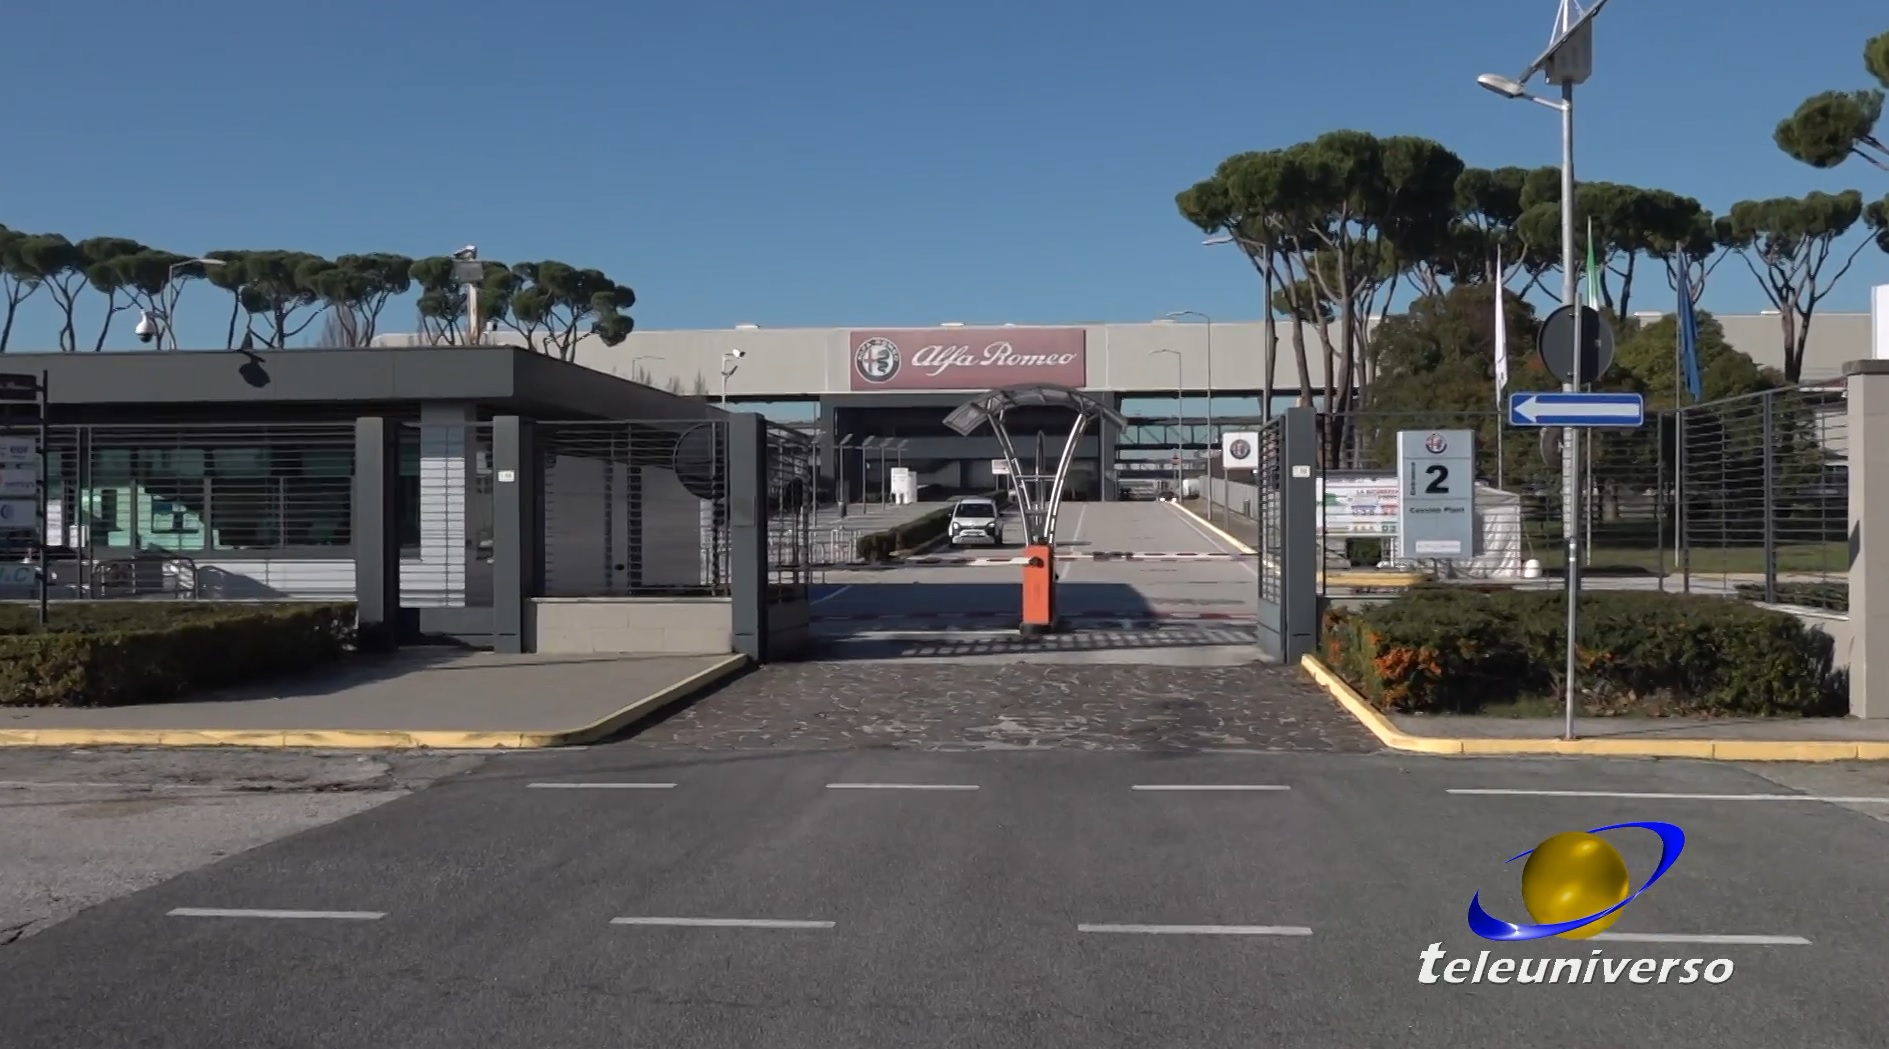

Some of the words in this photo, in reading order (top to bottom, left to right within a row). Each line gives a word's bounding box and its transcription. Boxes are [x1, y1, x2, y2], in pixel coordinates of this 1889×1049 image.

[911, 345, 979, 377] Alfa
[979, 341, 1077, 366] Romeo
[1425, 465, 1449, 493] 2
